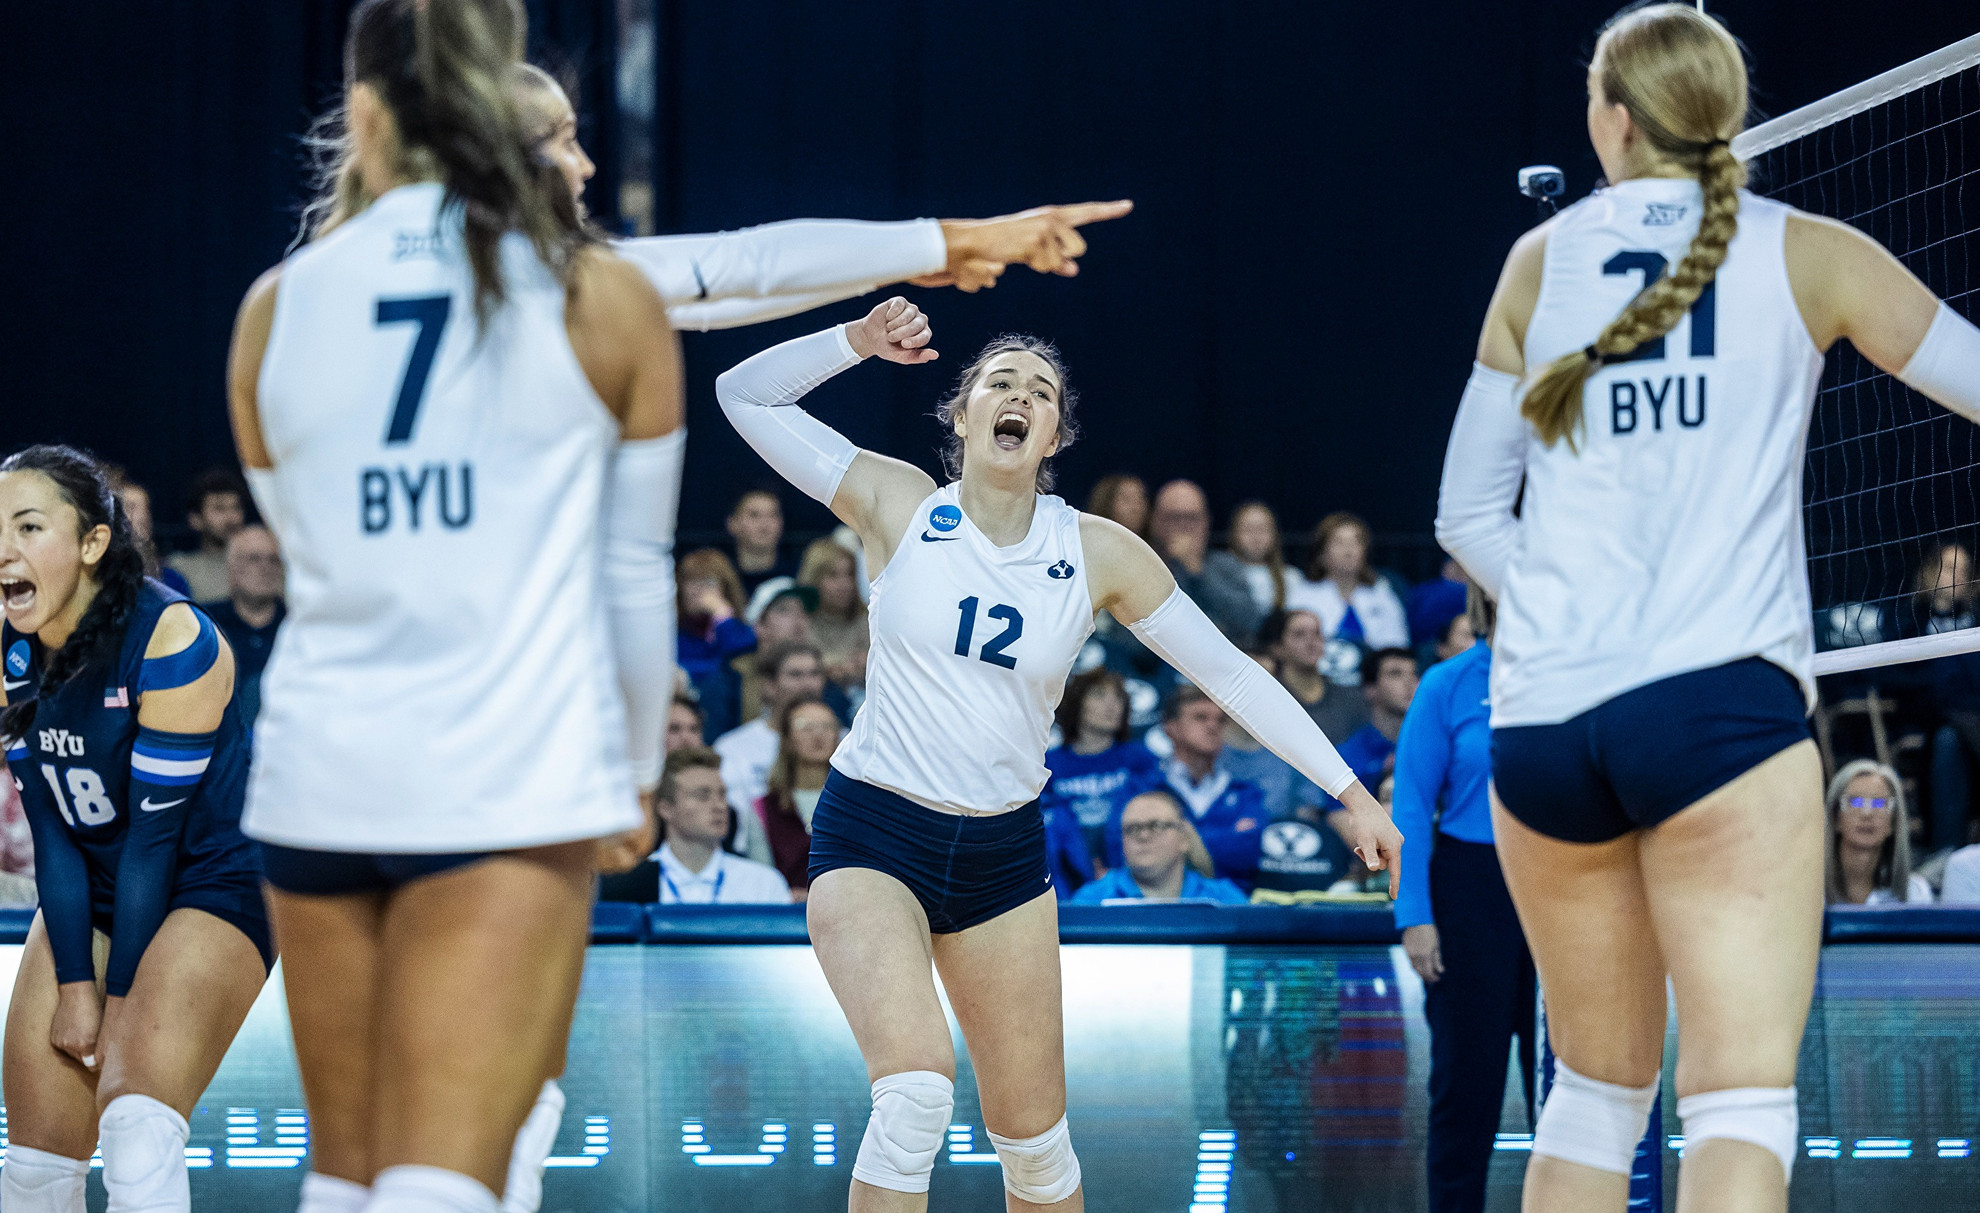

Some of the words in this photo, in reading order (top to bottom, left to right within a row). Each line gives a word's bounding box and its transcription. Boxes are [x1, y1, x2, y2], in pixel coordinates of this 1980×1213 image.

[375, 296, 451, 443] 7
[1610, 376, 1706, 435] BYU
[361, 463, 472, 535] BYU
[932, 514, 958, 526] NCAA
[954, 595, 1024, 670] 12
[38, 728, 85, 757] BYU
[40, 762, 117, 828] 18
